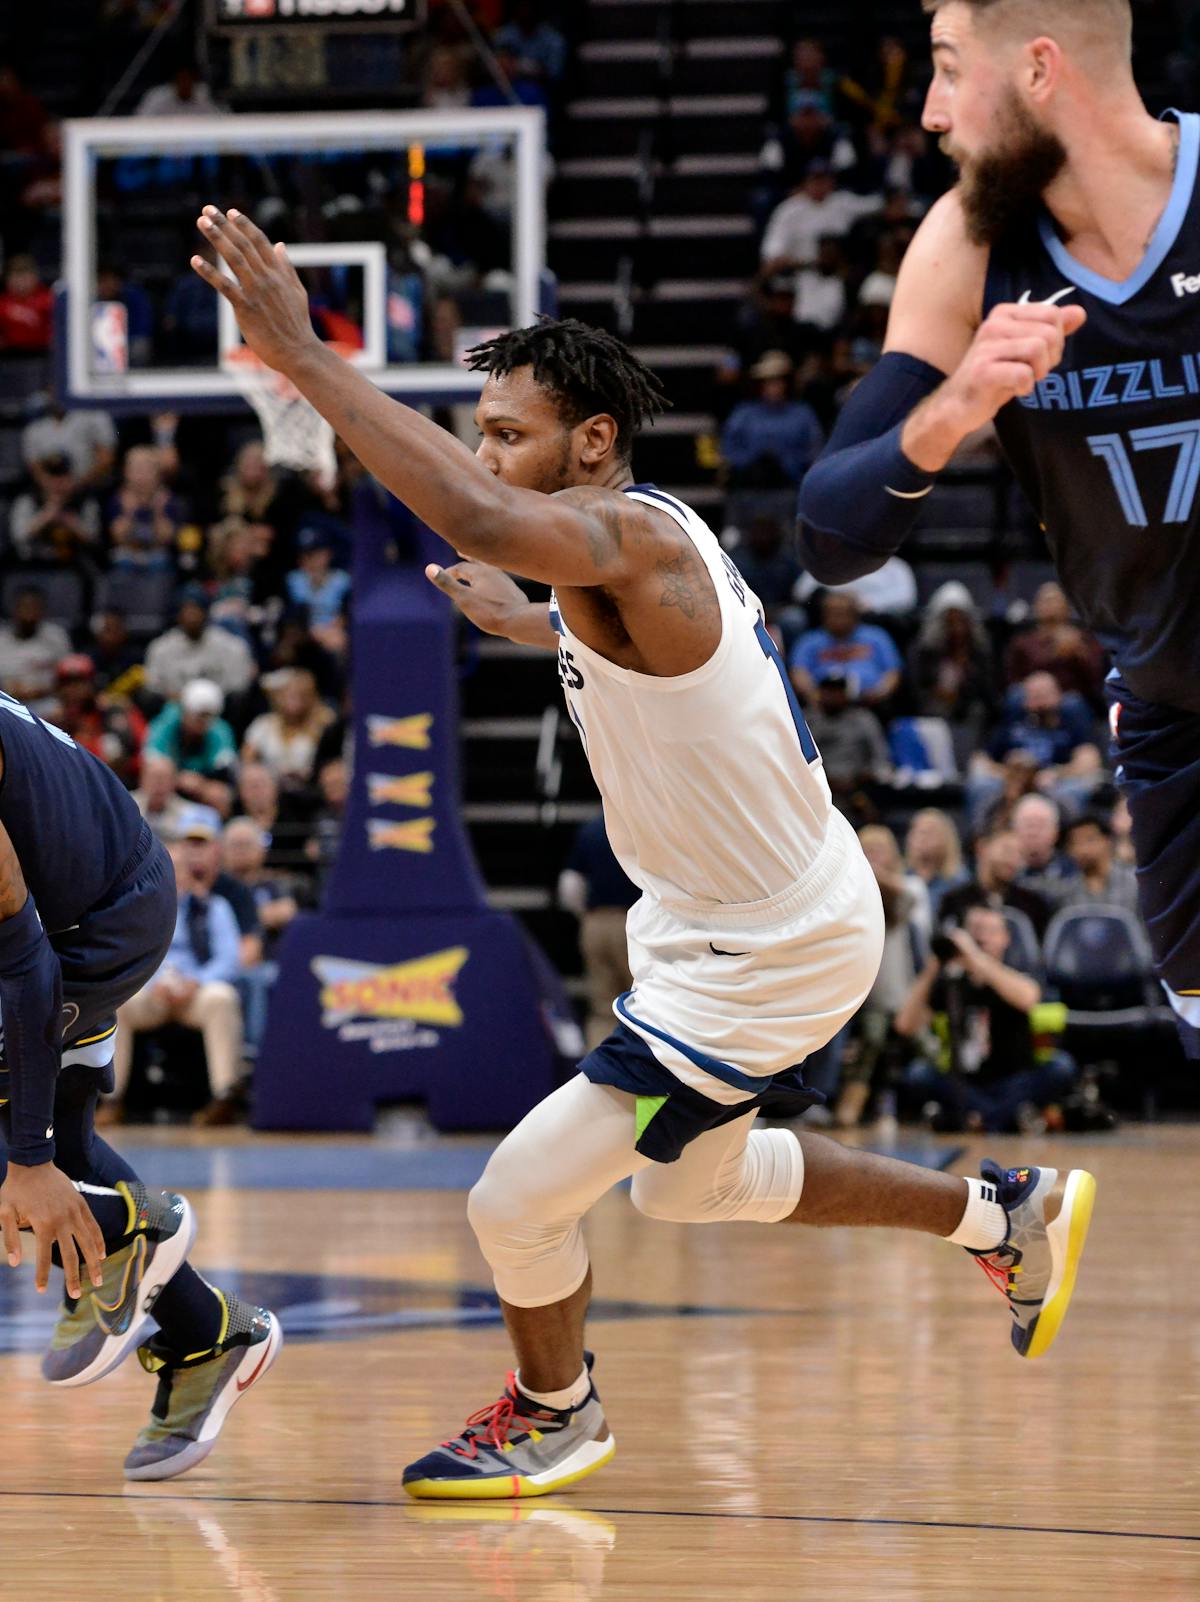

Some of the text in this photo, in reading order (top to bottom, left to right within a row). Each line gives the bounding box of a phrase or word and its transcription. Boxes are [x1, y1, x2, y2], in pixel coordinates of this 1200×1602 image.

[1170, 271, 1200, 298] Fe
[1016, 352, 1200, 411] RIZZLI
[1086, 417, 1200, 528] 17
